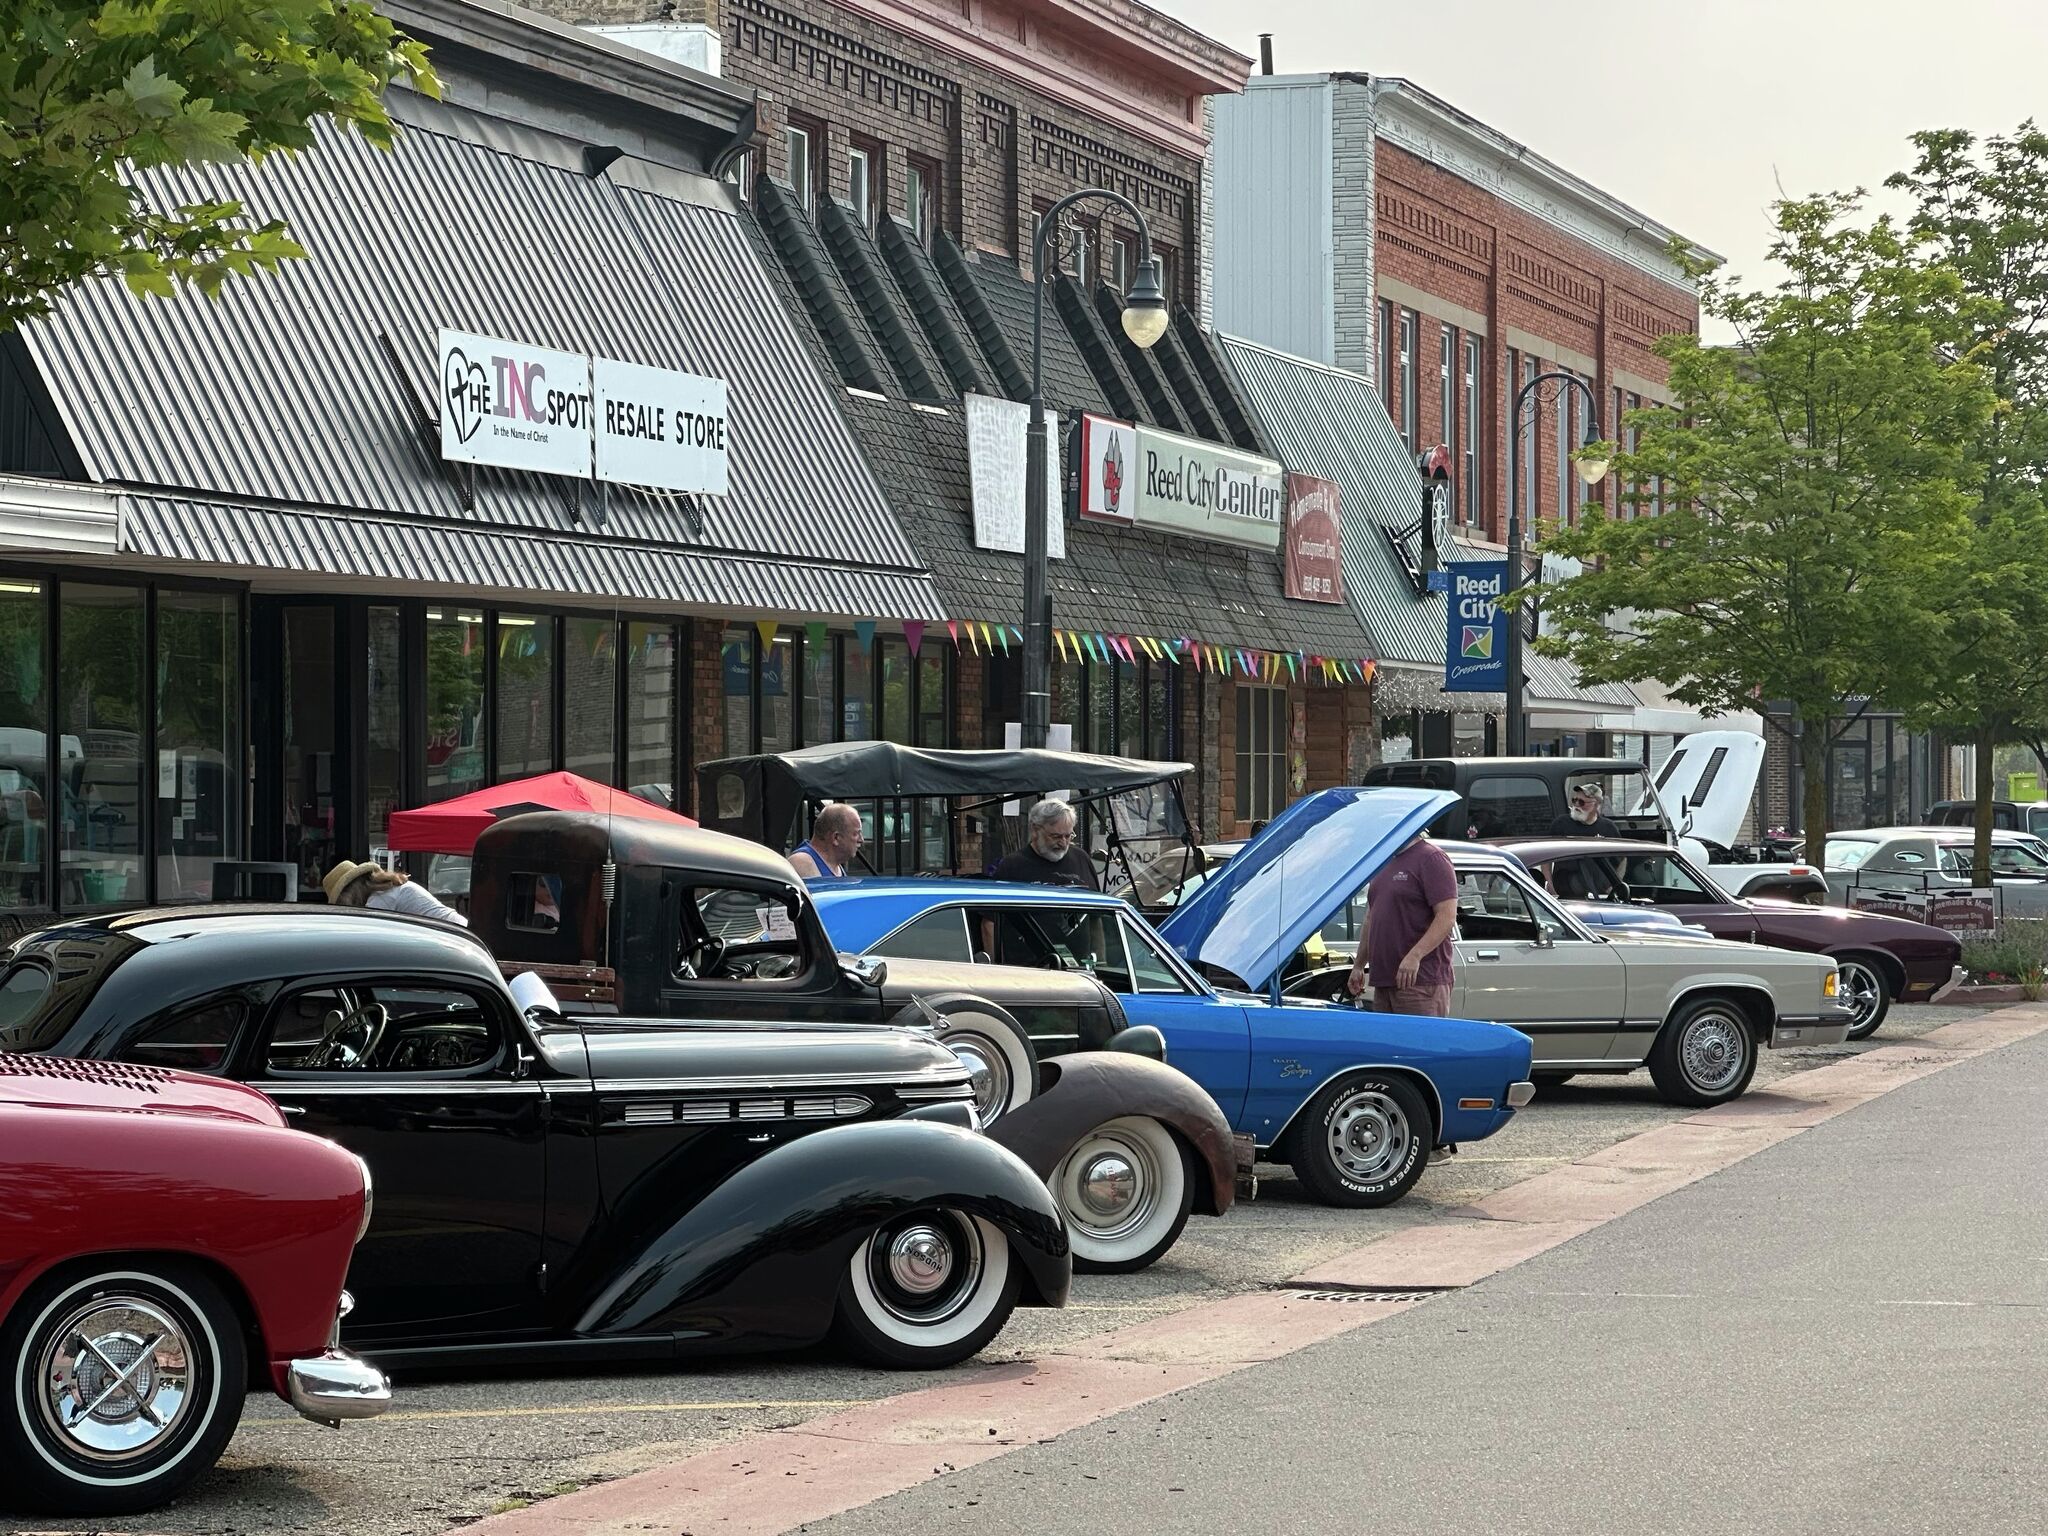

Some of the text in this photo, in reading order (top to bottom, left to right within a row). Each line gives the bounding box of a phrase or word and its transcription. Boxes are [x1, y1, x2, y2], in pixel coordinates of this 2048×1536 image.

[491, 356, 546, 424] INC
[547, 389, 589, 429] SPOT
[493, 424, 548, 443] In the Name of Christ
[606, 399, 724, 450] RESALE STORE
[1146, 450, 1279, 520] Reed City Center
[1456, 574, 1500, 595] Reed
[1460, 598, 1497, 624] City
[1451, 660, 1502, 679] Crossroads
[1323, 1087, 1358, 1127] RADIAL
[1341, 1135, 1420, 1193] COOPER COBRA
[906, 1246, 943, 1273] HUDSON
